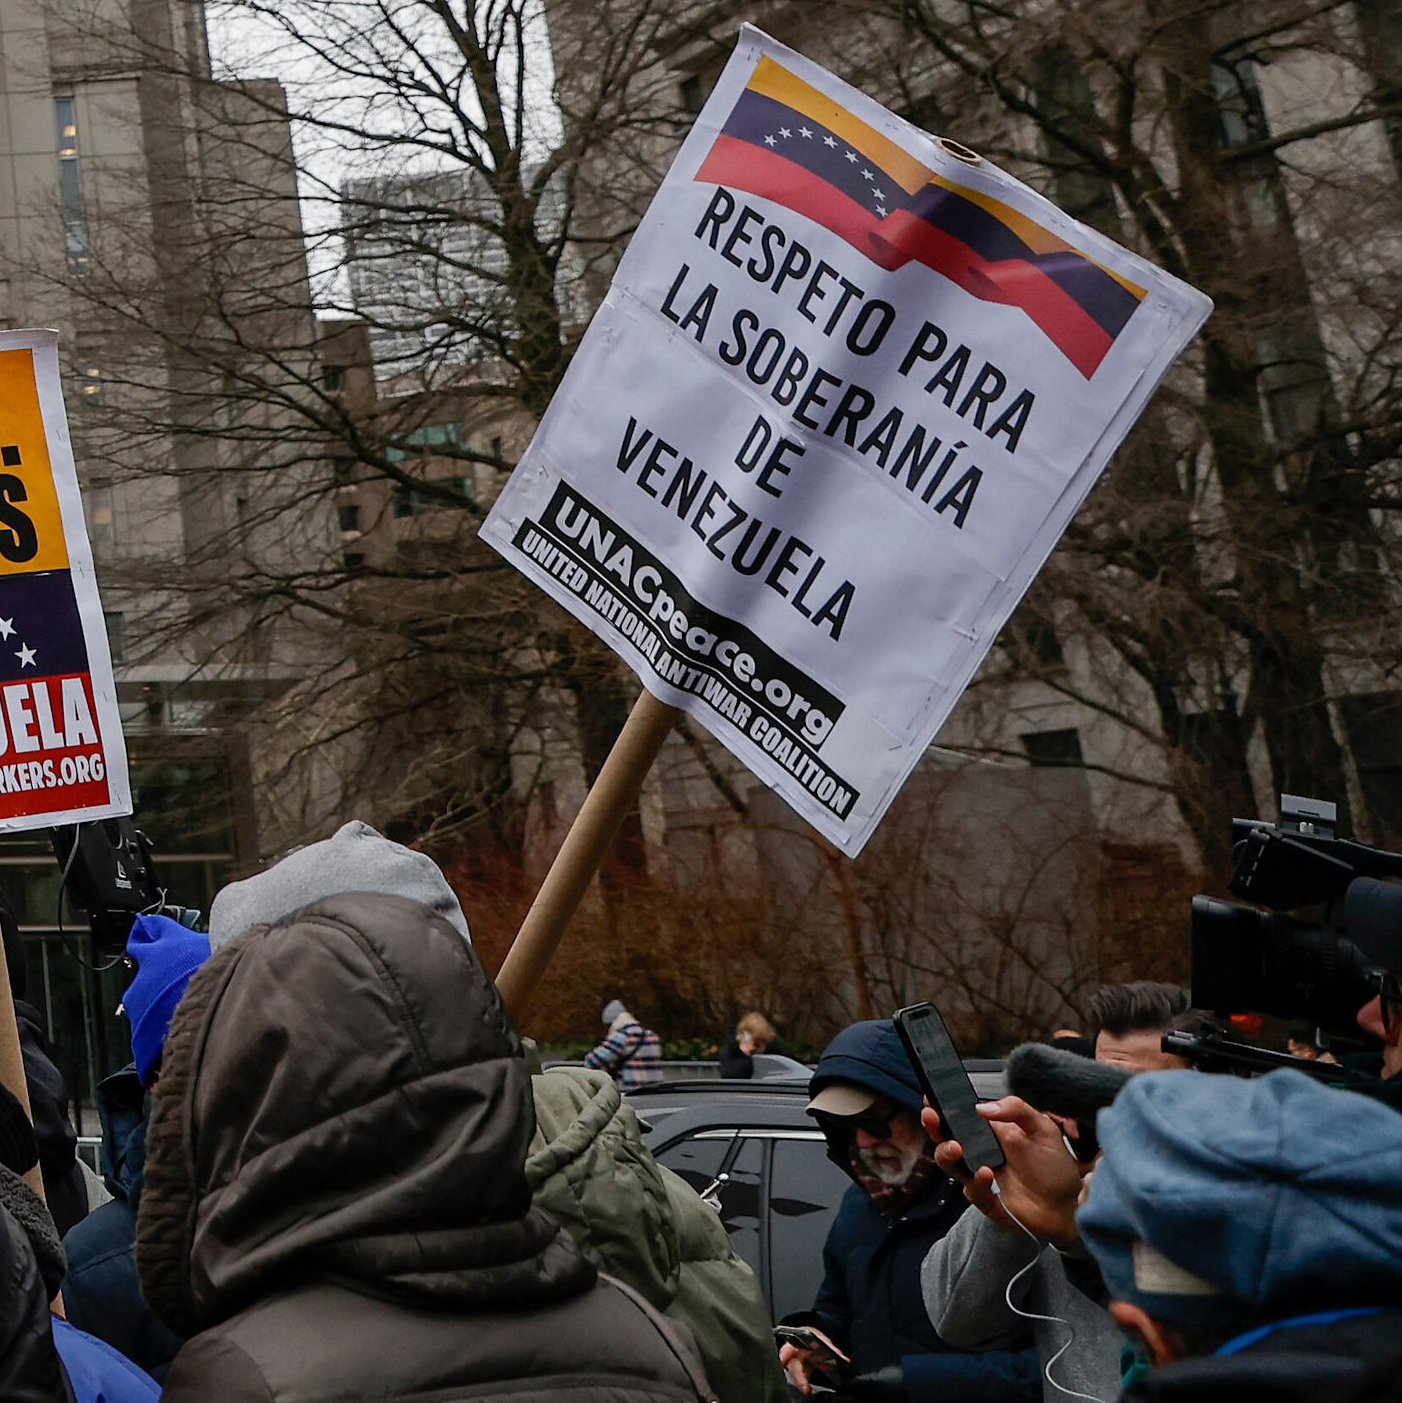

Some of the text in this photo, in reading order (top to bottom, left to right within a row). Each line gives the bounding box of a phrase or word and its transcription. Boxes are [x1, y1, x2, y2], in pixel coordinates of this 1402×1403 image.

[659, 263, 984, 530] LA SOBERANÍA
[695, 186, 1036, 455] RESPETO PARA
[616, 415, 856, 642] VENEZUELA
[734, 414, 808, 499] DE
[523, 528, 853, 815] UNITED NATIONAL ANTIWAR COALITION
[555, 496, 835, 746] UNACpeace.org
